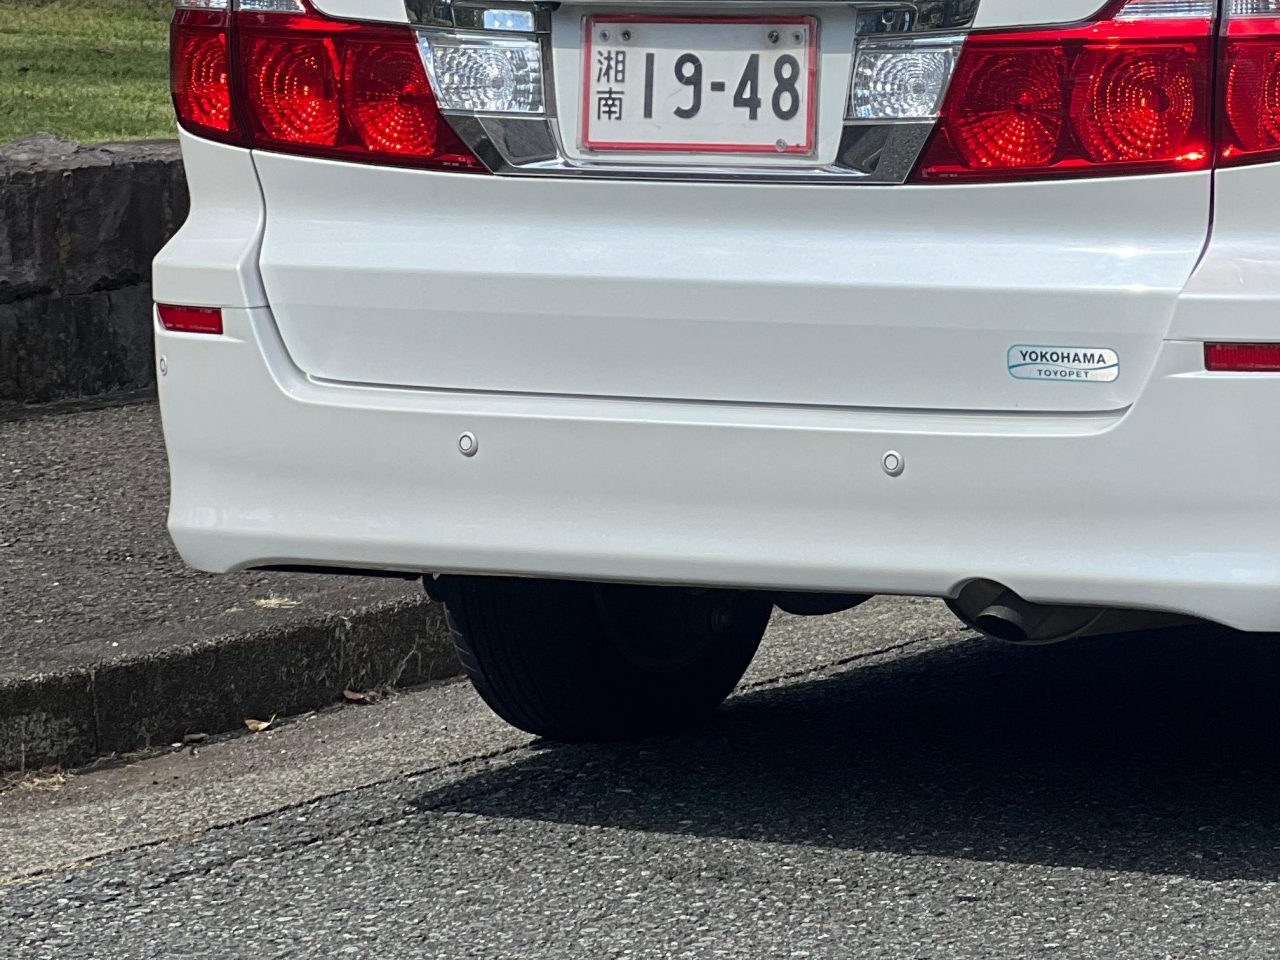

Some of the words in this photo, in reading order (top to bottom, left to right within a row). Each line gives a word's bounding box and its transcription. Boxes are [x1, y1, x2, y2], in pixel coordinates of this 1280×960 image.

[596, 50, 627, 120] 湘南
[643, 52, 801, 121] 19-48
[1019, 350, 1107, 365] YOKOHAMA
[1037, 369, 1089, 378] TOYOPET
